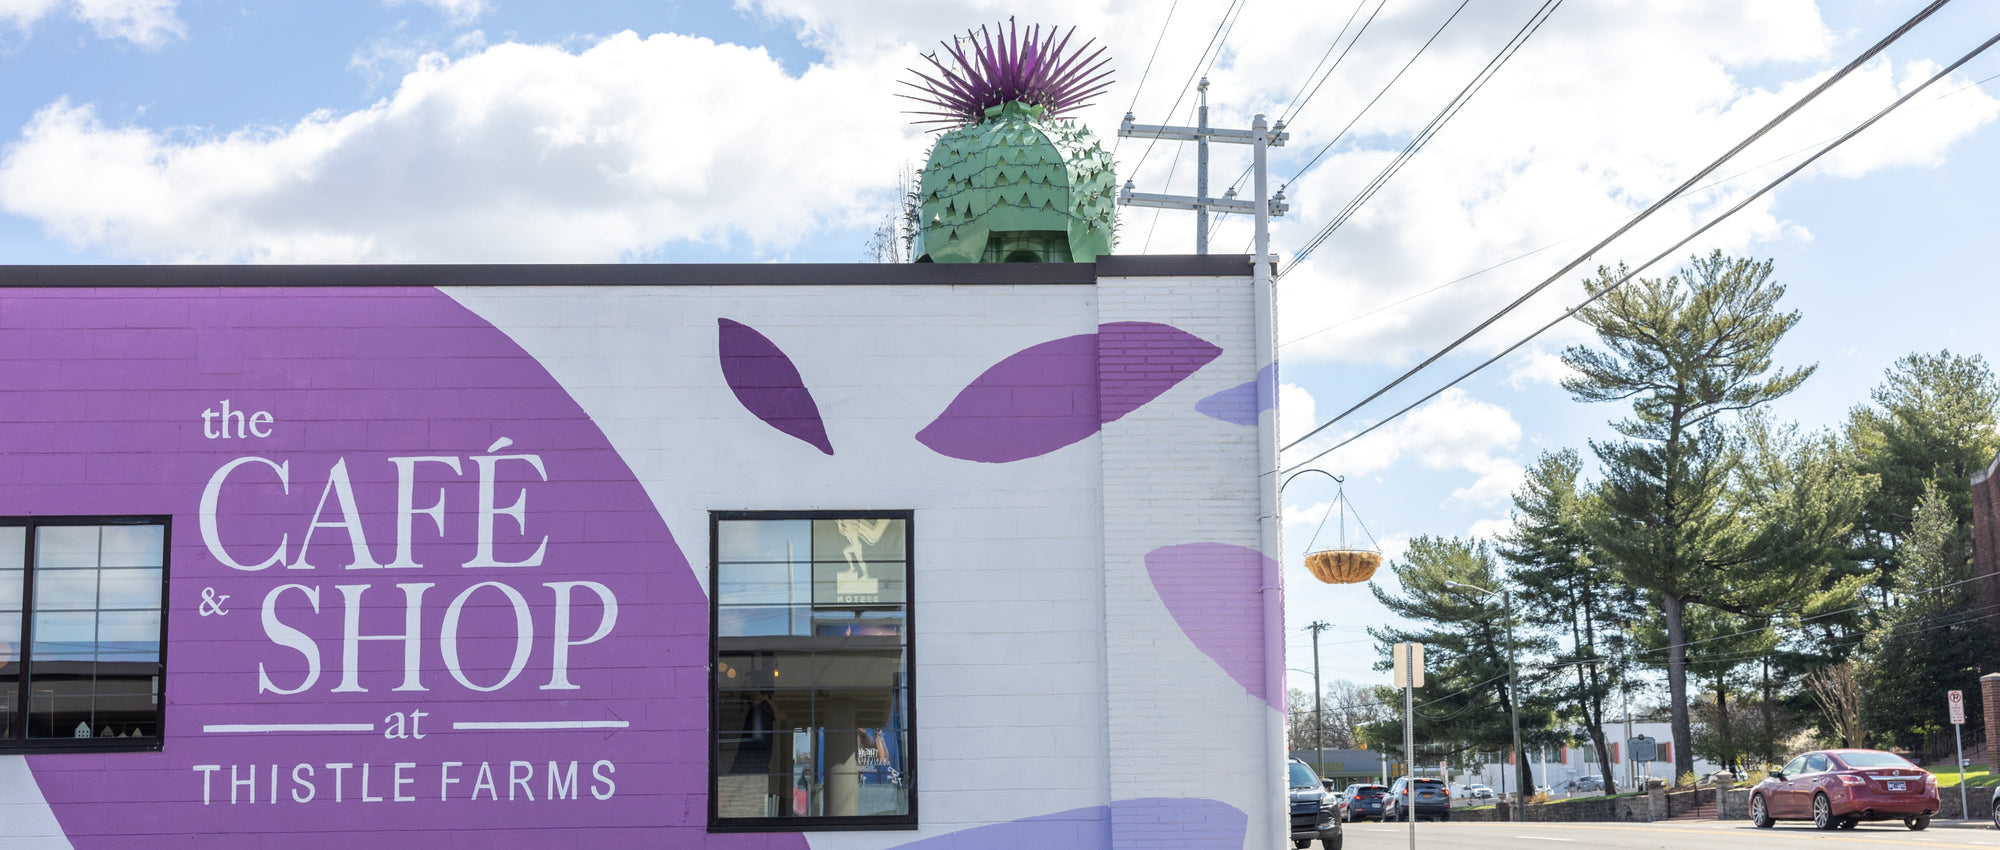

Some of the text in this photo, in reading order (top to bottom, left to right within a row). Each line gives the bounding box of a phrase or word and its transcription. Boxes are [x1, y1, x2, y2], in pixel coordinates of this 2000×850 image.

[201, 399, 274, 439] the
[199, 436, 549, 571] CAFÉ
[198, 581, 618, 695] & SHOP
[384, 708, 429, 740] at
[193, 759, 616, 806] THISTLE FARMS
